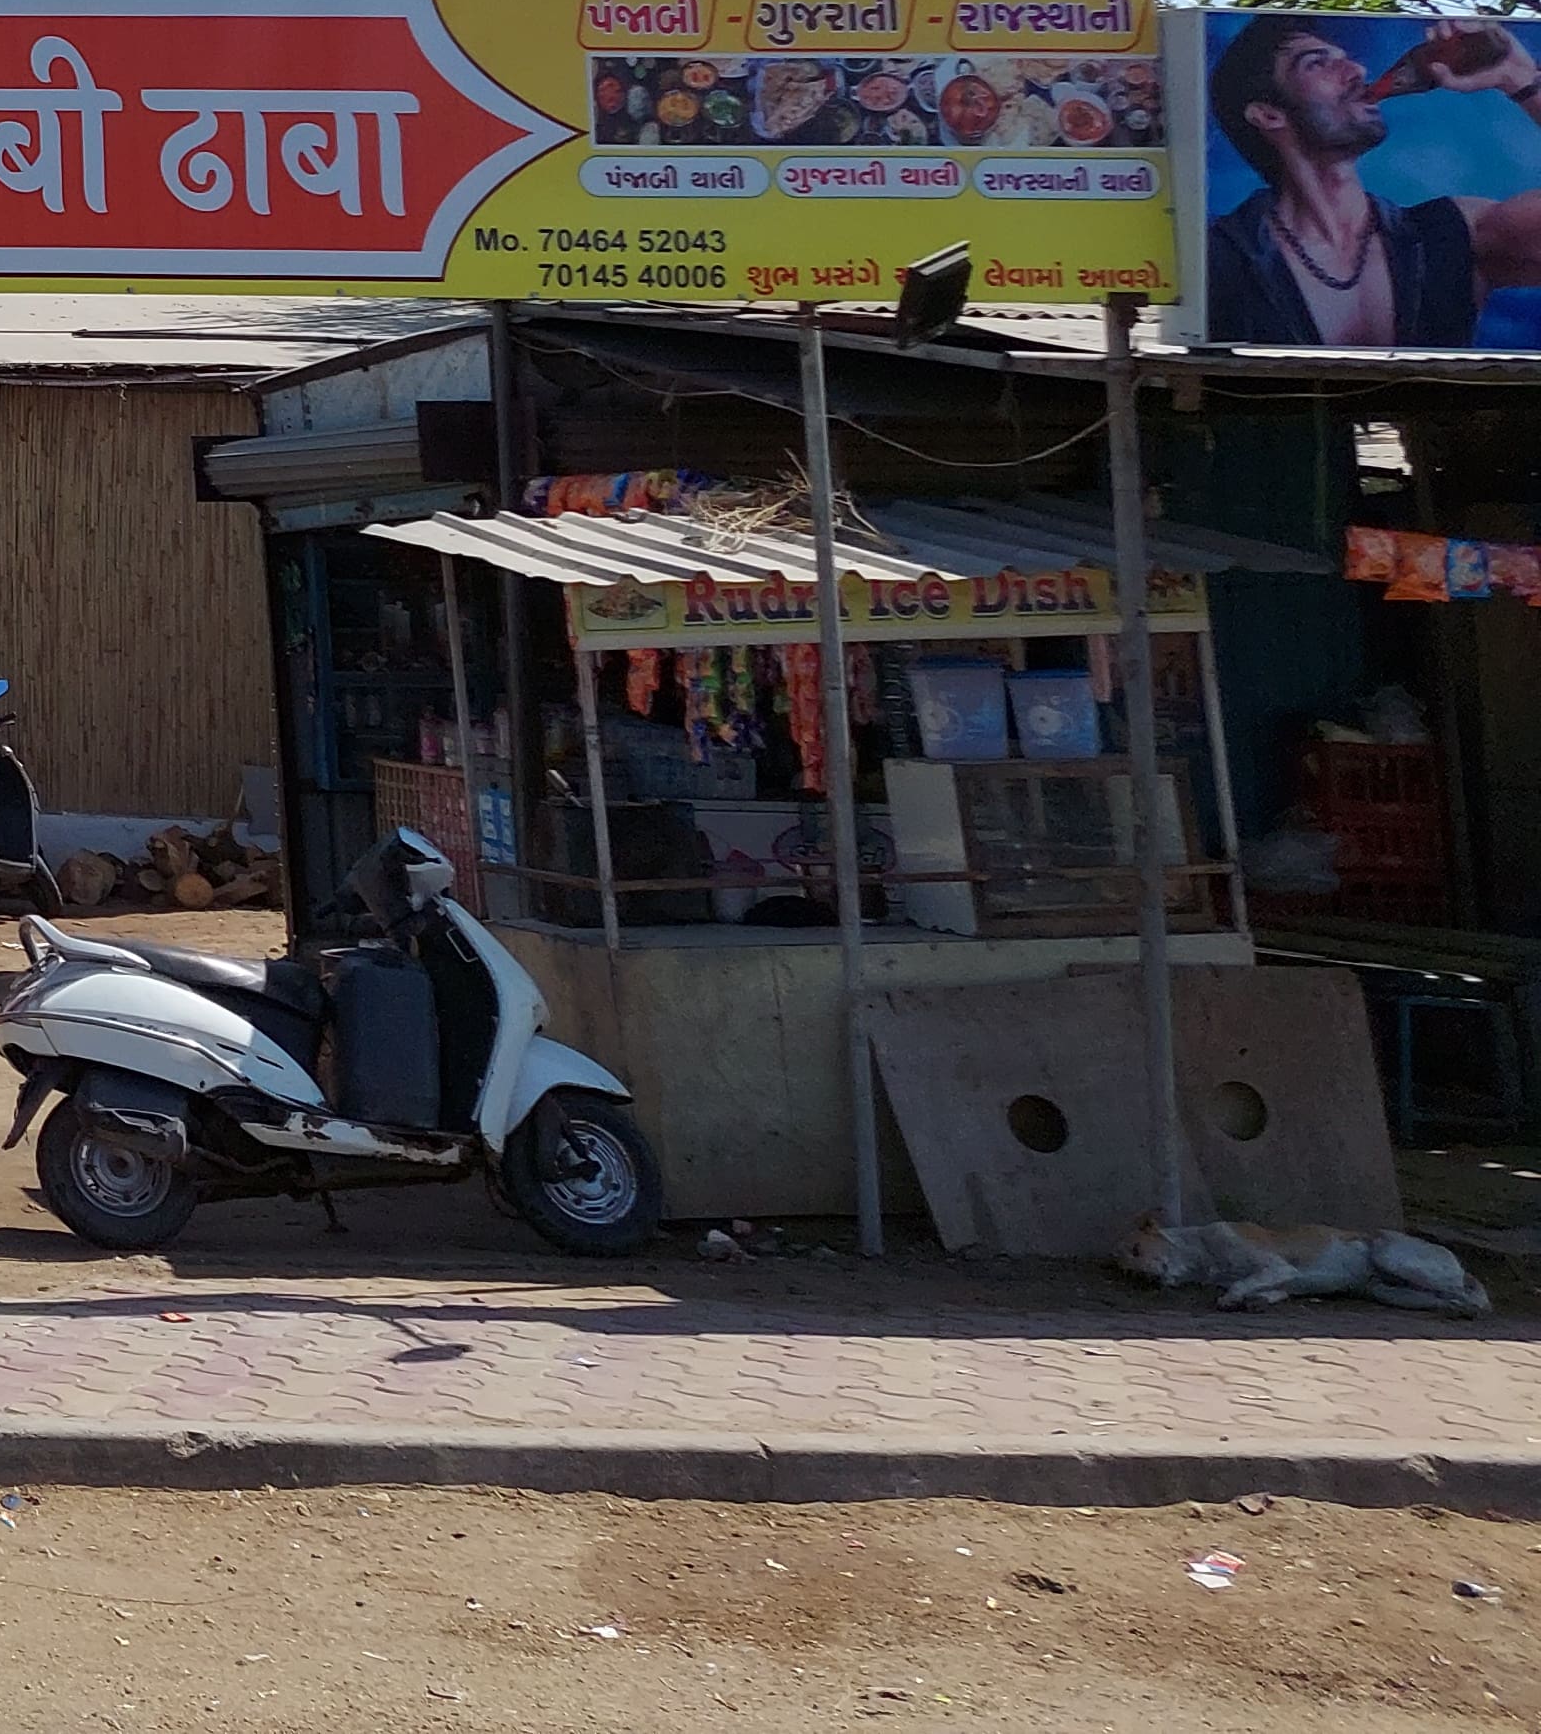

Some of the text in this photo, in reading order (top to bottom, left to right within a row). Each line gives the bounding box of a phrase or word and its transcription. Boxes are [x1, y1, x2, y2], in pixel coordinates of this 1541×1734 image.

[140, 88, 421, 217] ढाबा
[604, 164, 678, 190] પંજાબી
[783, 160, 887, 195] ગુજરાતી
[982, 165, 1090, 192] રાજસ્થાની
[474, 227, 727, 254] Mo. 70464 52043
[538, 263, 727, 289] 70145 40006
[747, 265, 799, 296] શુભ
[682, 569, 1101, 625] Rudr Ice Dish
